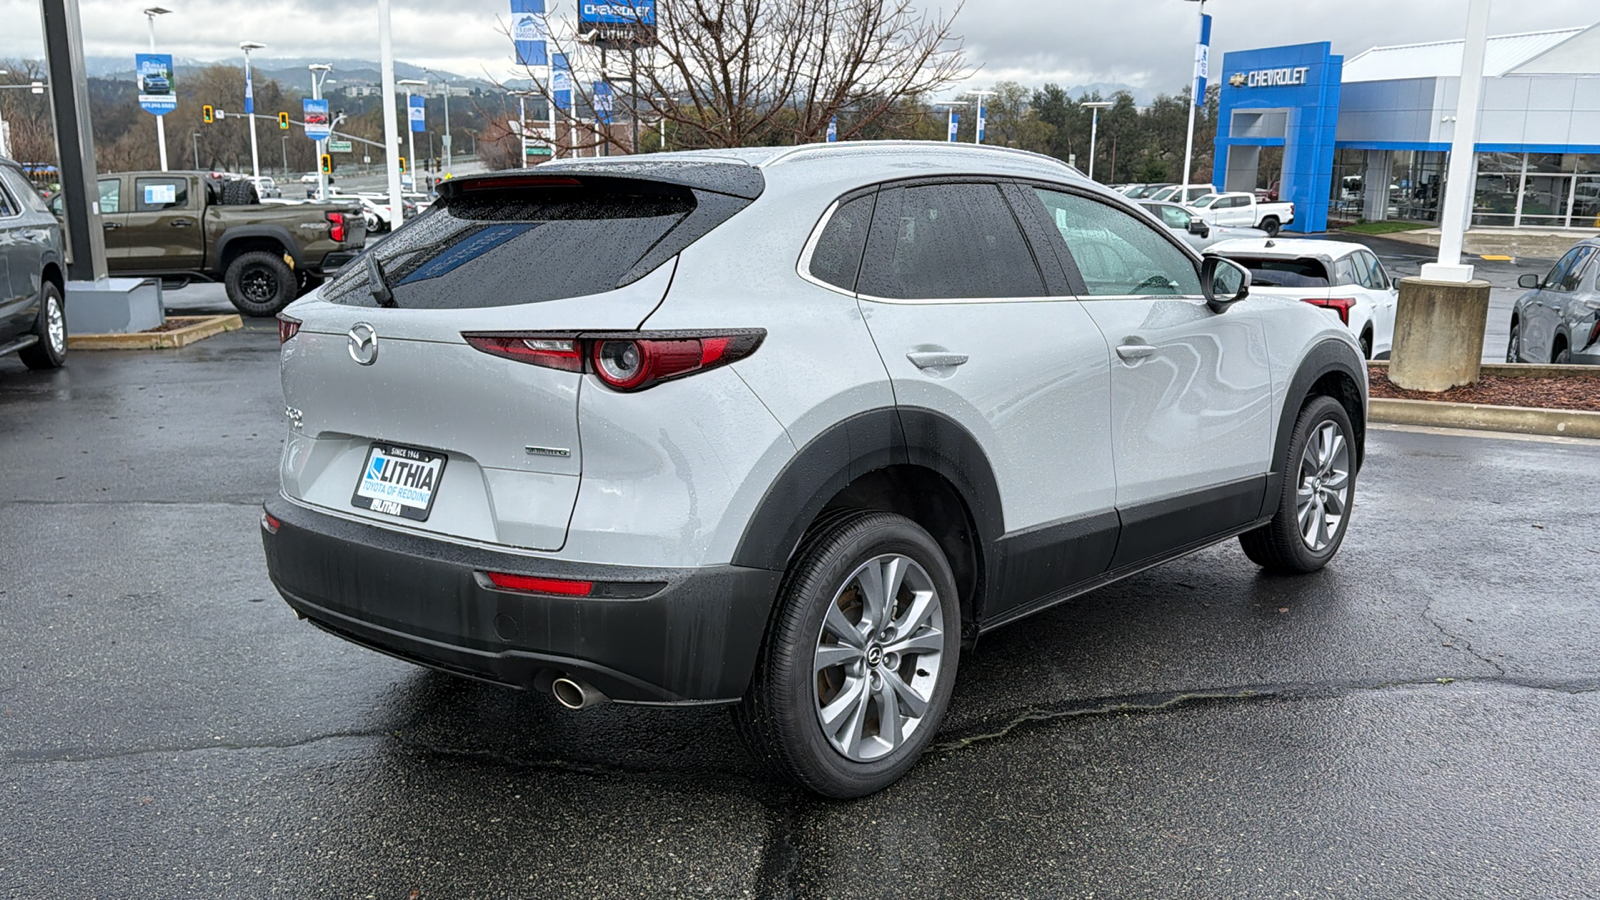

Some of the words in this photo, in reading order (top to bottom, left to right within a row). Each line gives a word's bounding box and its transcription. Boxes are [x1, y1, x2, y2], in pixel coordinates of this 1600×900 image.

[584, 4, 650, 16] CHEVROLET
[601, 30, 635, 39] LITHIA
[1248, 67, 1308, 87] CHEVROLET
[391, 448, 406, 457] SINCE
[407, 450, 419, 459] 1946
[380, 459, 434, 491] LITHIA
[363, 481, 386, 494] TOYOTA
[387, 486, 398, 495] OF
[397, 488, 429, 503] REDDING
[378, 500, 401, 516] LITHIA
